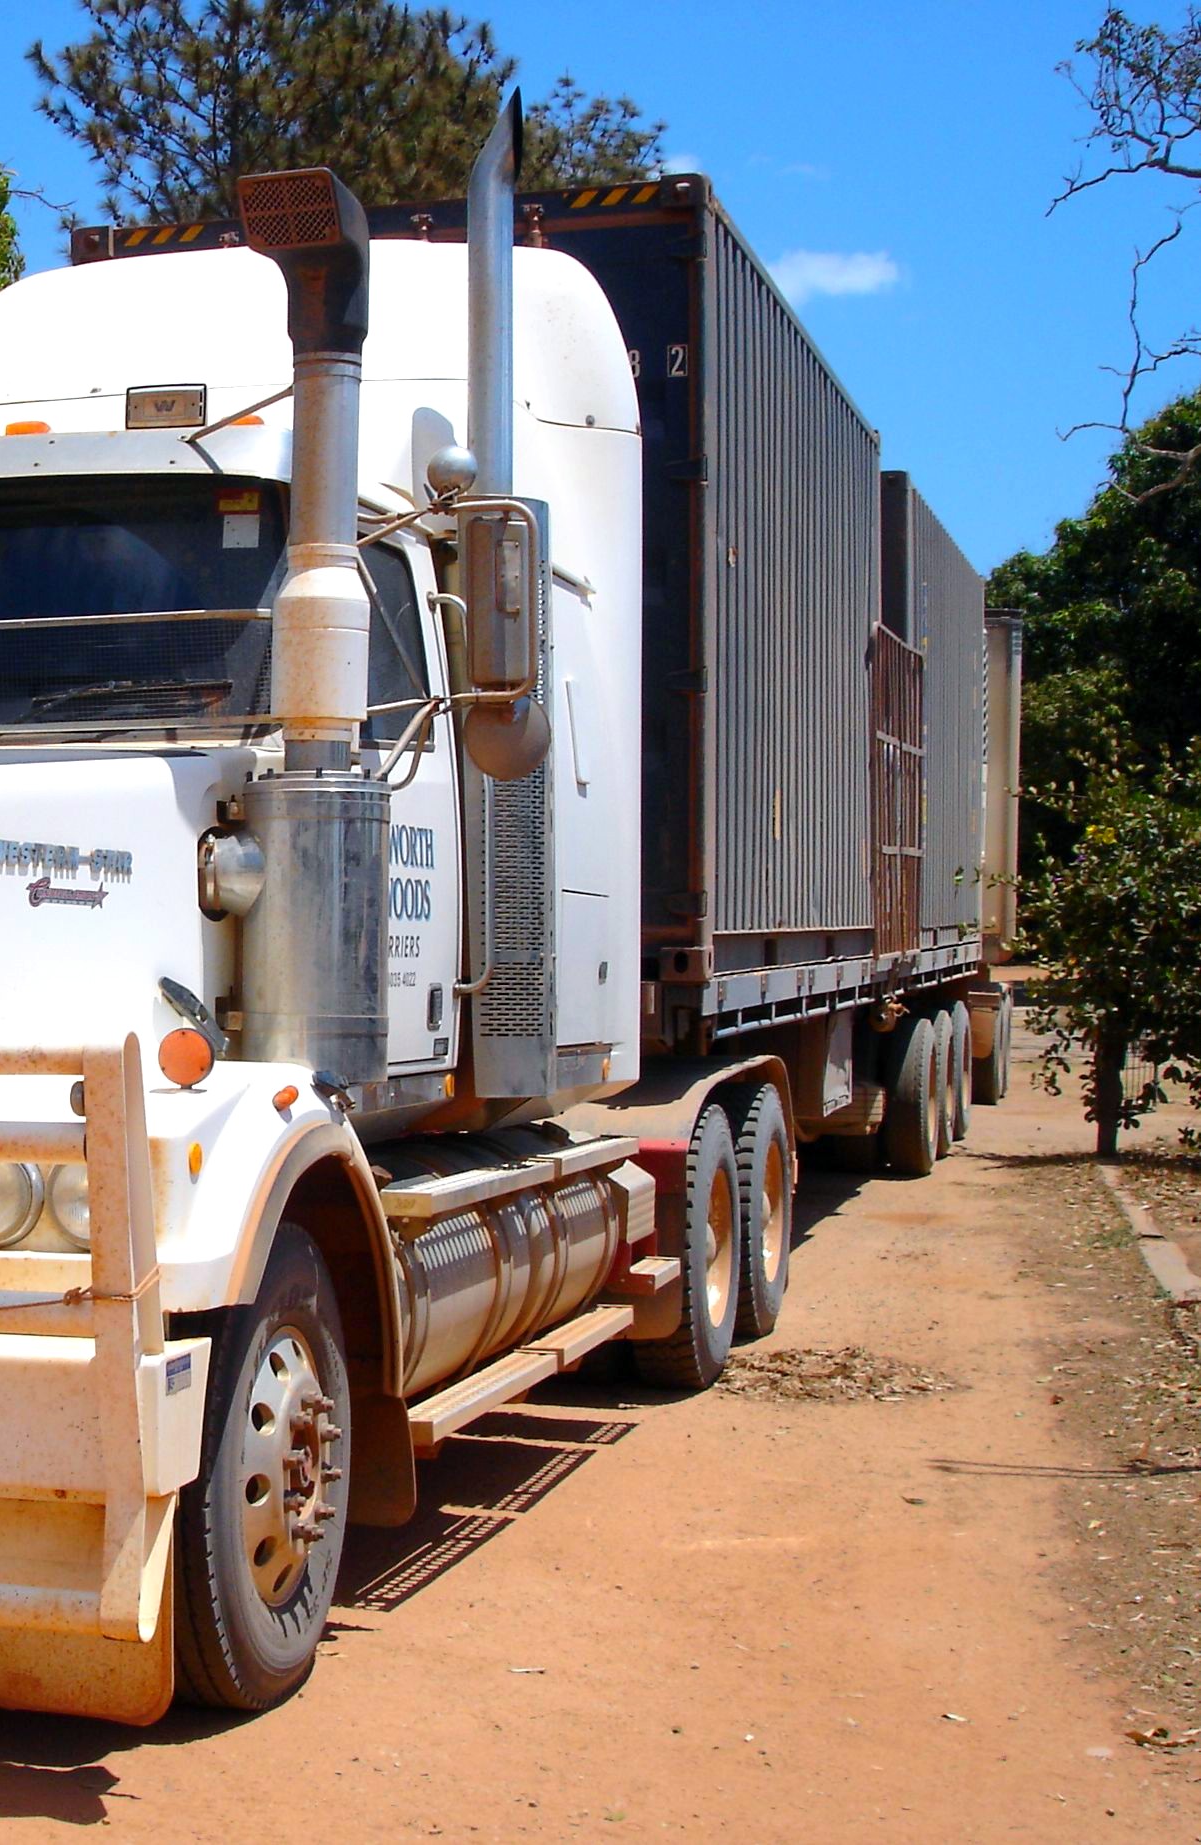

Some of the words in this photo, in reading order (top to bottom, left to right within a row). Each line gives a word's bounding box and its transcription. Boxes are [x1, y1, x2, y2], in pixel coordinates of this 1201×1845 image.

[670, 346, 685, 377] 2
[388, 823, 435, 870] NORTH
[388, 935, 421, 959] RRIERS
